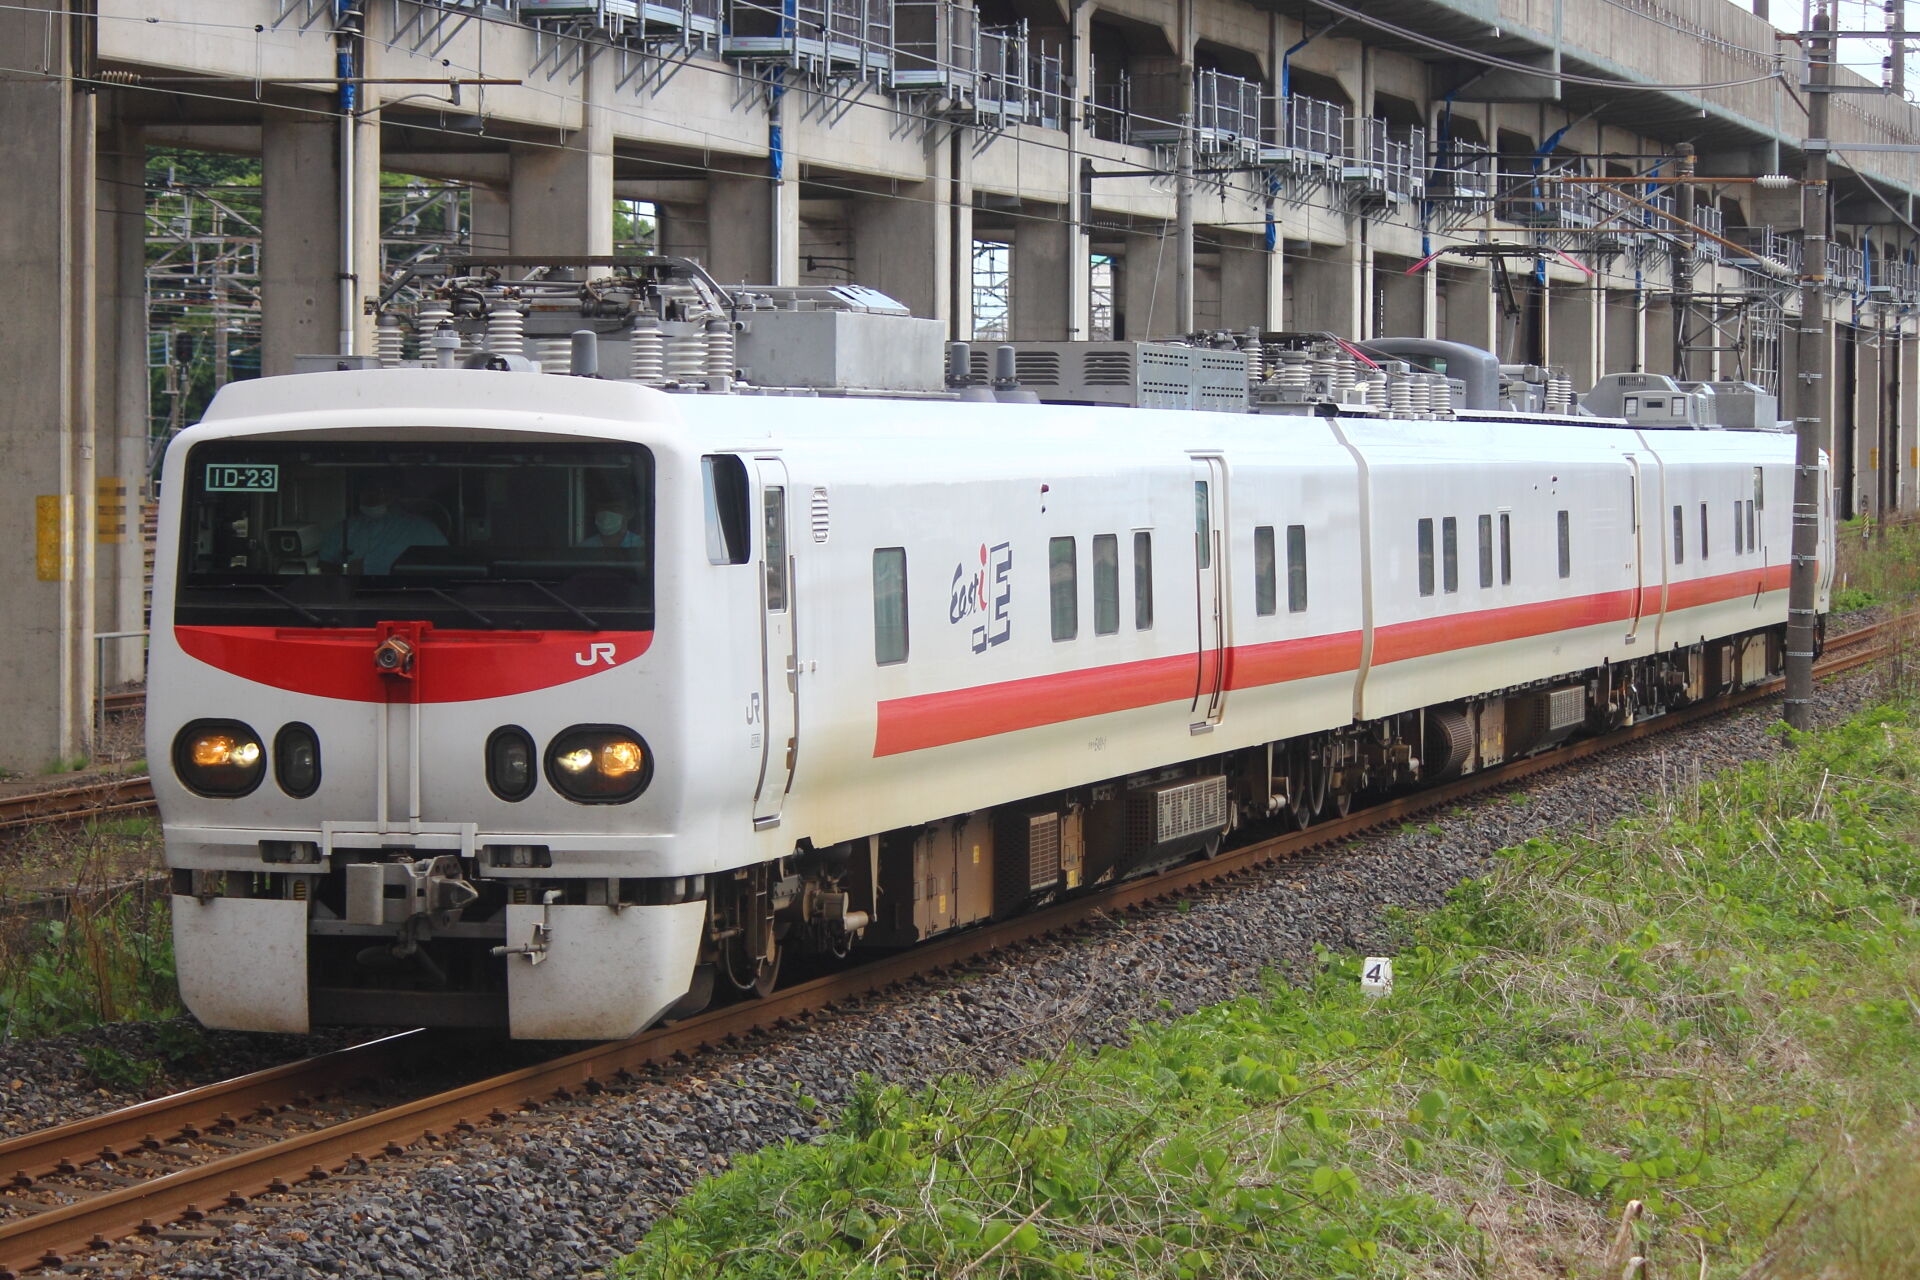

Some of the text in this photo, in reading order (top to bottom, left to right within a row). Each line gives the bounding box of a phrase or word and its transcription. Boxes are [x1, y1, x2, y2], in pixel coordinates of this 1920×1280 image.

[215, 468, 273, 487] ID-23
[575, 642, 616, 666] JR
[745, 691, 760, 725] JR
[1366, 963, 1381, 983] 4
